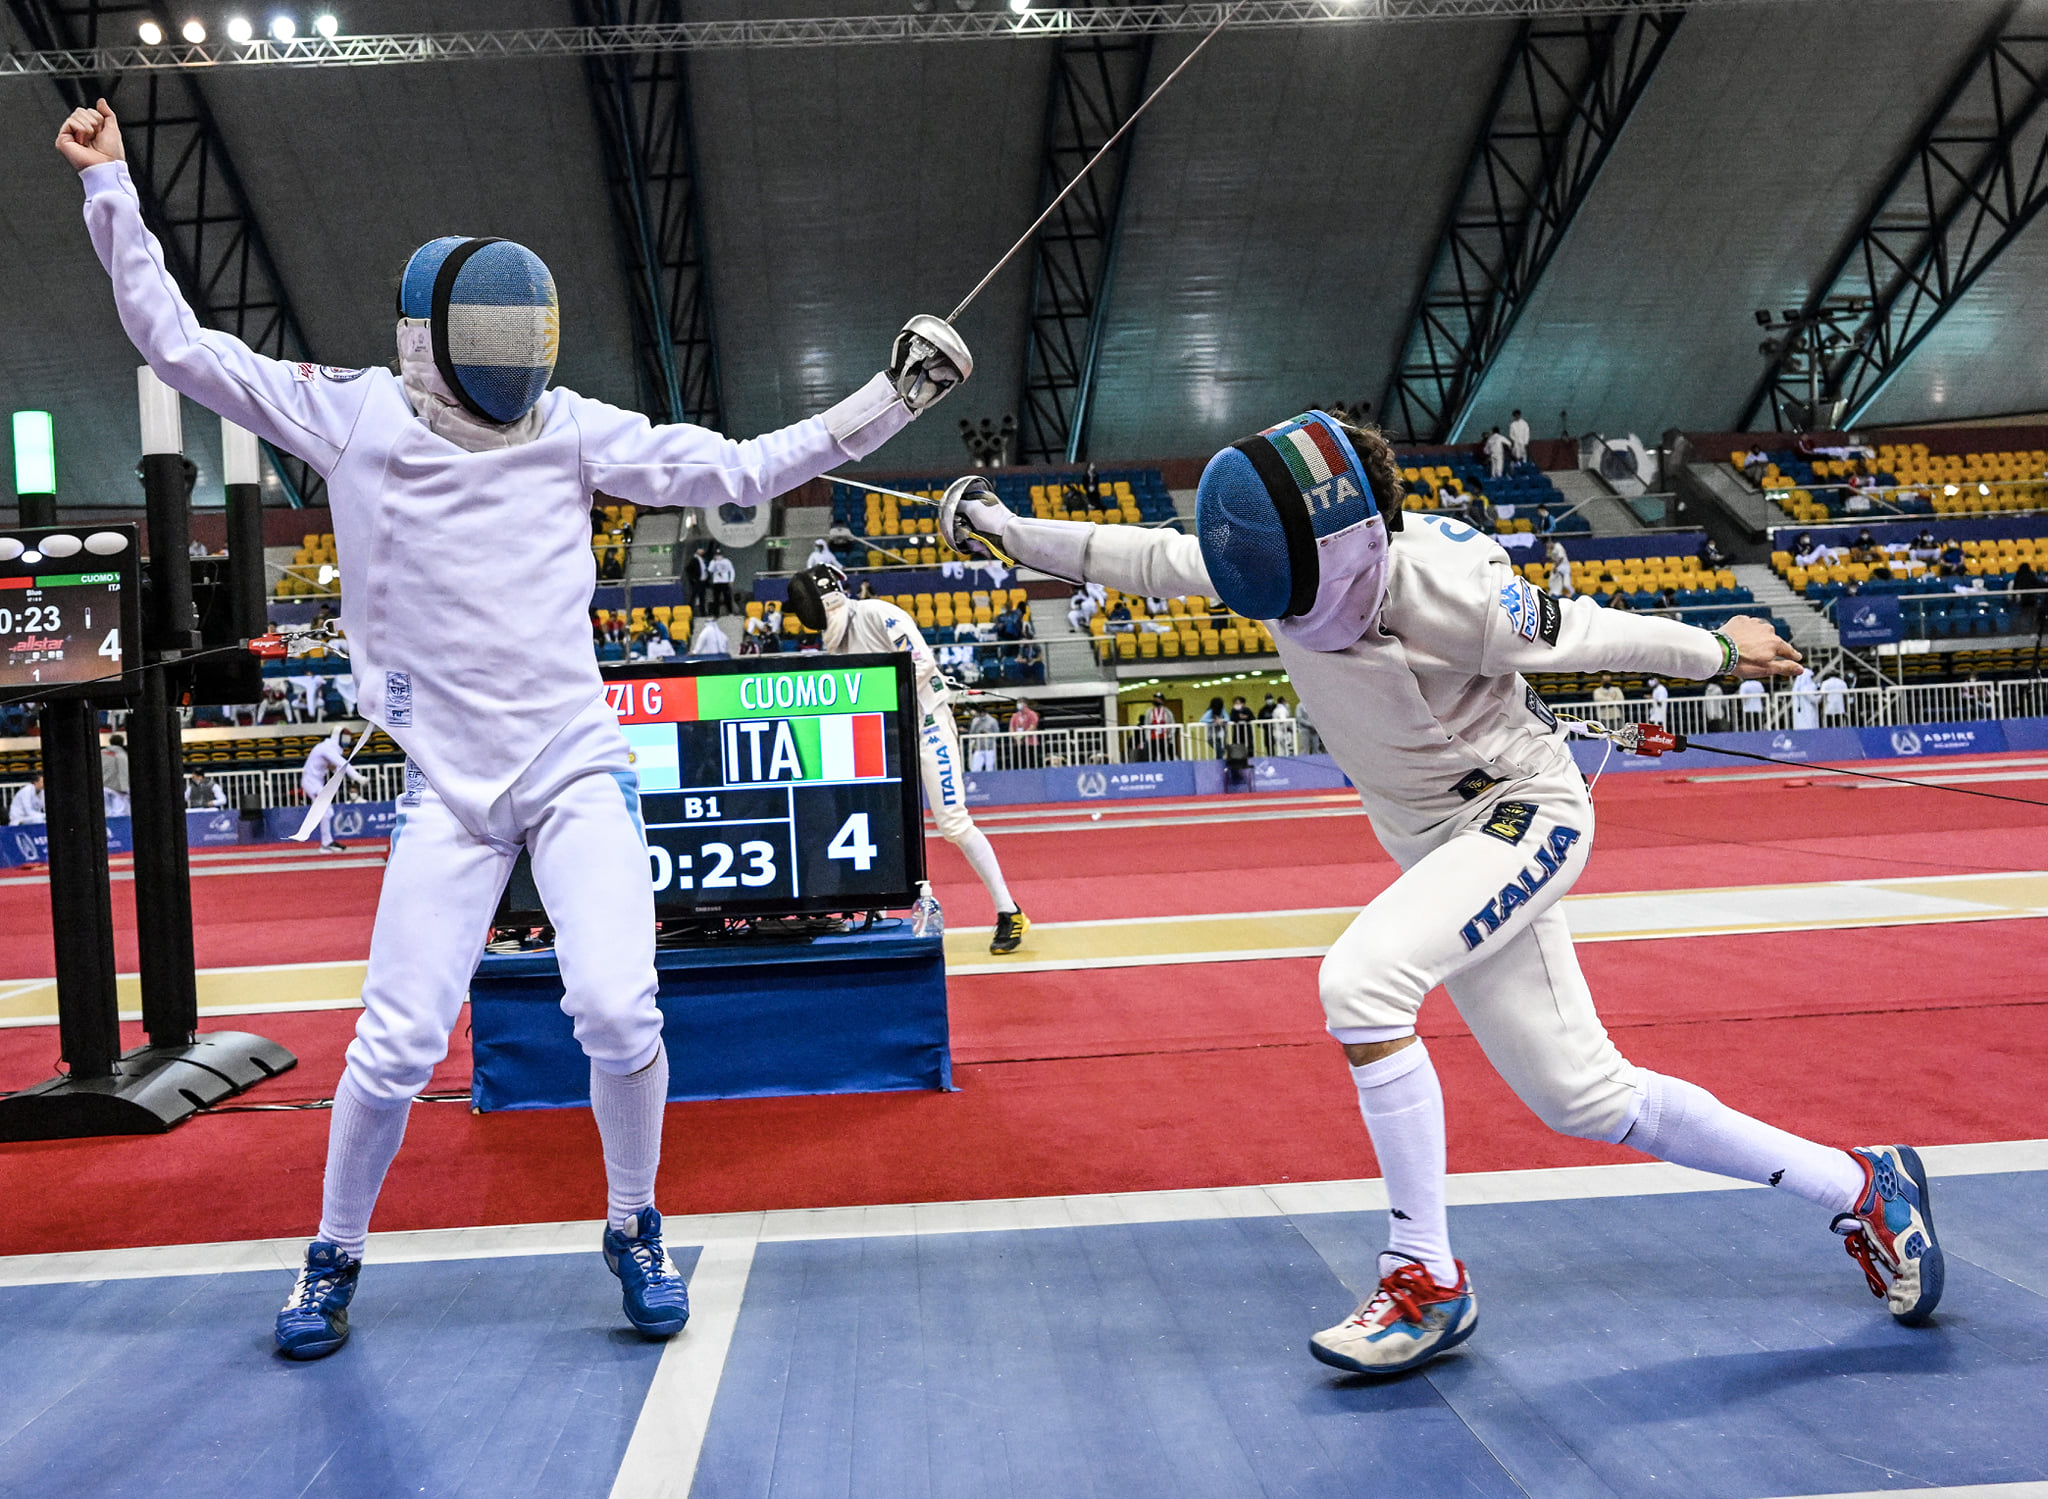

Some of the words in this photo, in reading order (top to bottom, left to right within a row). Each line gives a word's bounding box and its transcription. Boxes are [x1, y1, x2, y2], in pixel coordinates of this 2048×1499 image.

[1302, 476, 1359, 516] ITA
[81, 574, 114, 583] CUOMO
[108, 584, 121, 592] ITA
[12, 635, 64, 652] allstar
[98, 628, 122, 662] 4
[33, 668, 40, 682] 1
[740, 673, 838, 710] CUOMO
[844, 673, 862, 705] V
[642, 682, 663, 715] G
[727, 720, 803, 782] ITA
[936, 745, 957, 806] ITALIA
[1111, 773, 1164, 783] ASPIRE
[684, 796, 721, 819] B1
[827, 812, 878, 871] 4
[1460, 825, 1582, 951] ITALIA
